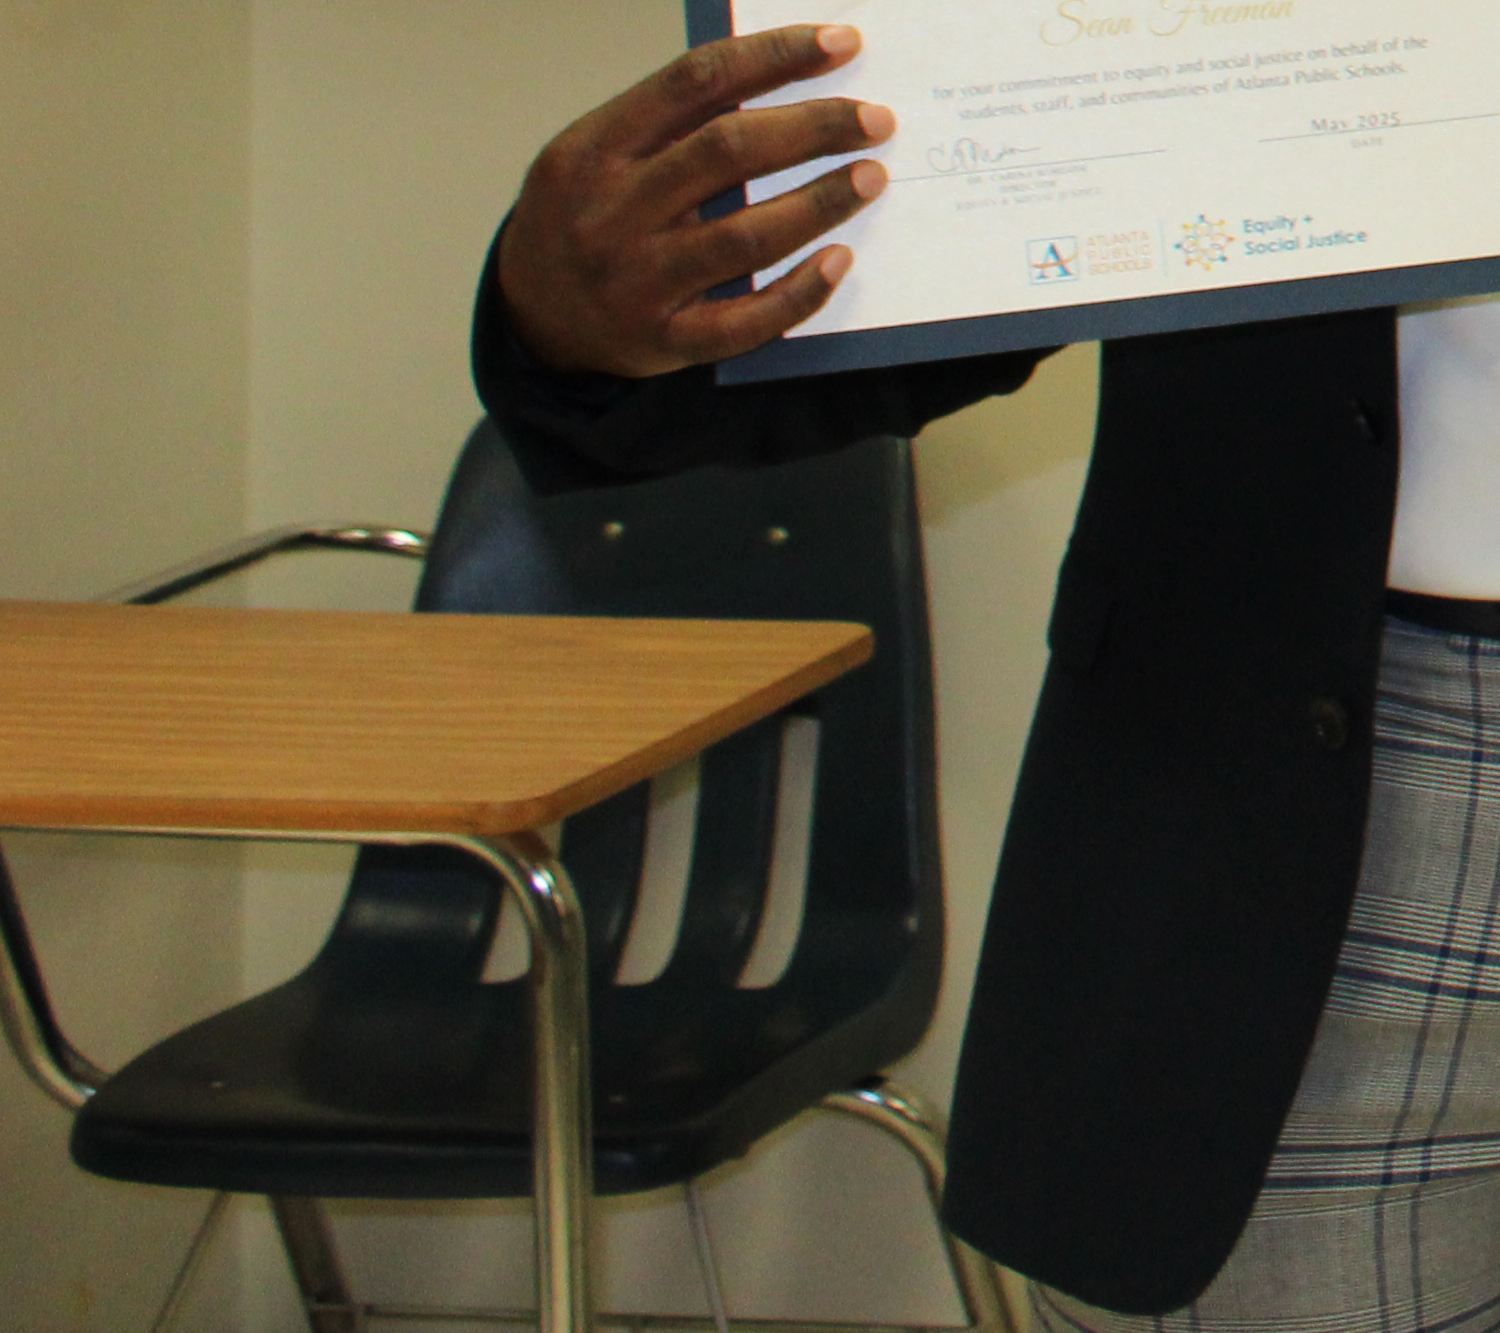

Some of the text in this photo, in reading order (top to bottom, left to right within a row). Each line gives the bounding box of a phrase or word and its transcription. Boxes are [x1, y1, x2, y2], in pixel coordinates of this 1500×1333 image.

[933, 35, 1429, 102] for your commitment to equity and social justice on behalf of the
[1078, 92, 1107, 108] and
[1110, 83, 1210, 105] communities
[1213, 78, 1231, 95] of
[1235, 72, 1291, 91] Atlanta
[1293, 68, 1340, 86] Public
[1344, 60, 1409, 81] Schools.
[1310, 110, 1401, 133] May 2025
[1242, 215, 1297, 237] Equity
[1087, 230, 1149, 249] ATLANTA
[1243, 229, 1369, 257] Social Justice
[1087, 244, 1151, 261] PUBLIC
[1088, 258, 1153, 276] SCHOOLS
